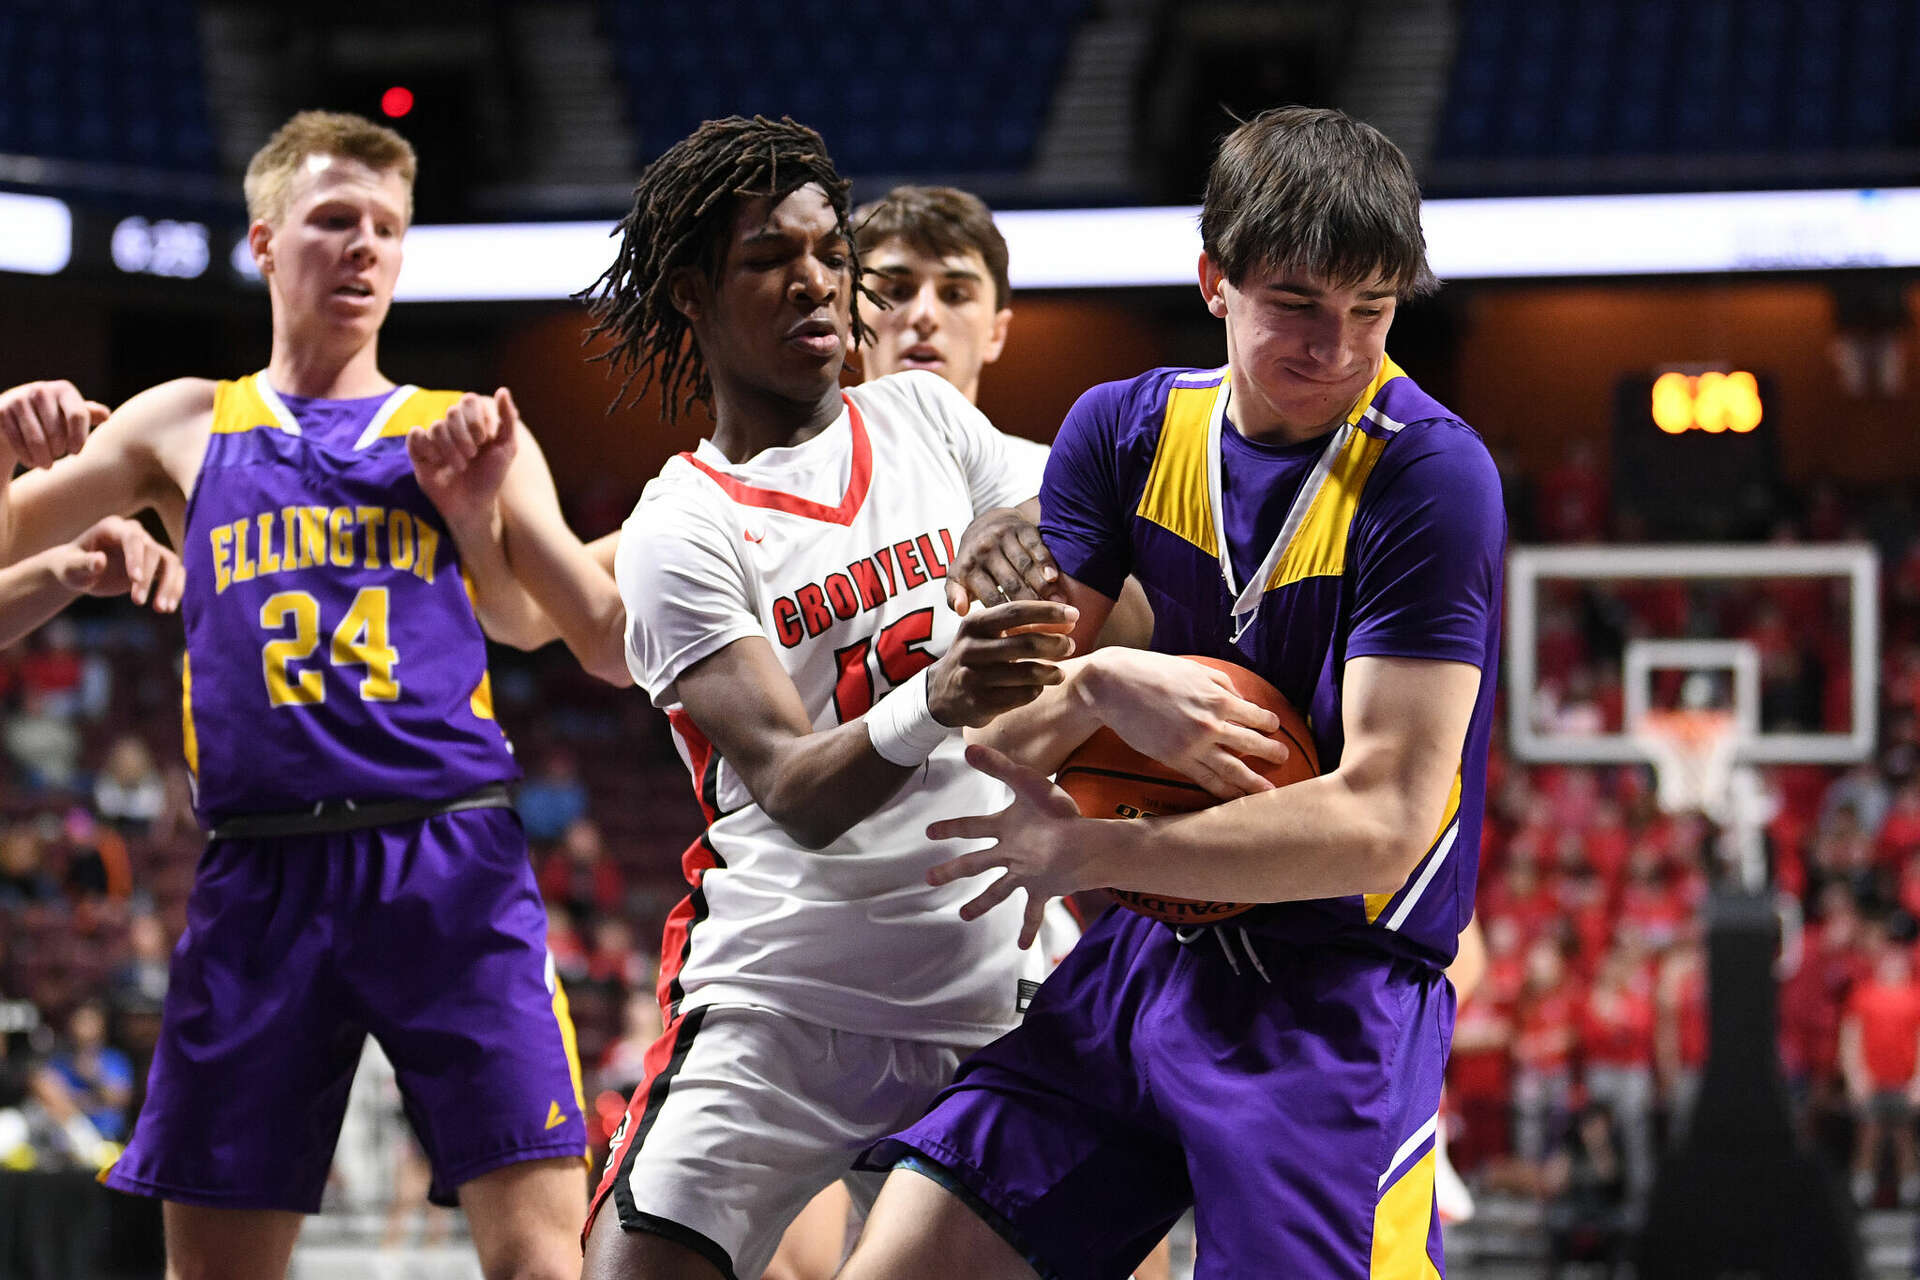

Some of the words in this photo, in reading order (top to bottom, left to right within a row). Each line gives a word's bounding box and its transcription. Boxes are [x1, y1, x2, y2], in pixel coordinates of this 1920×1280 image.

[210, 505, 439, 595] ELLINGTON
[260, 586, 400, 708] 24
[834, 606, 940, 725] 15
